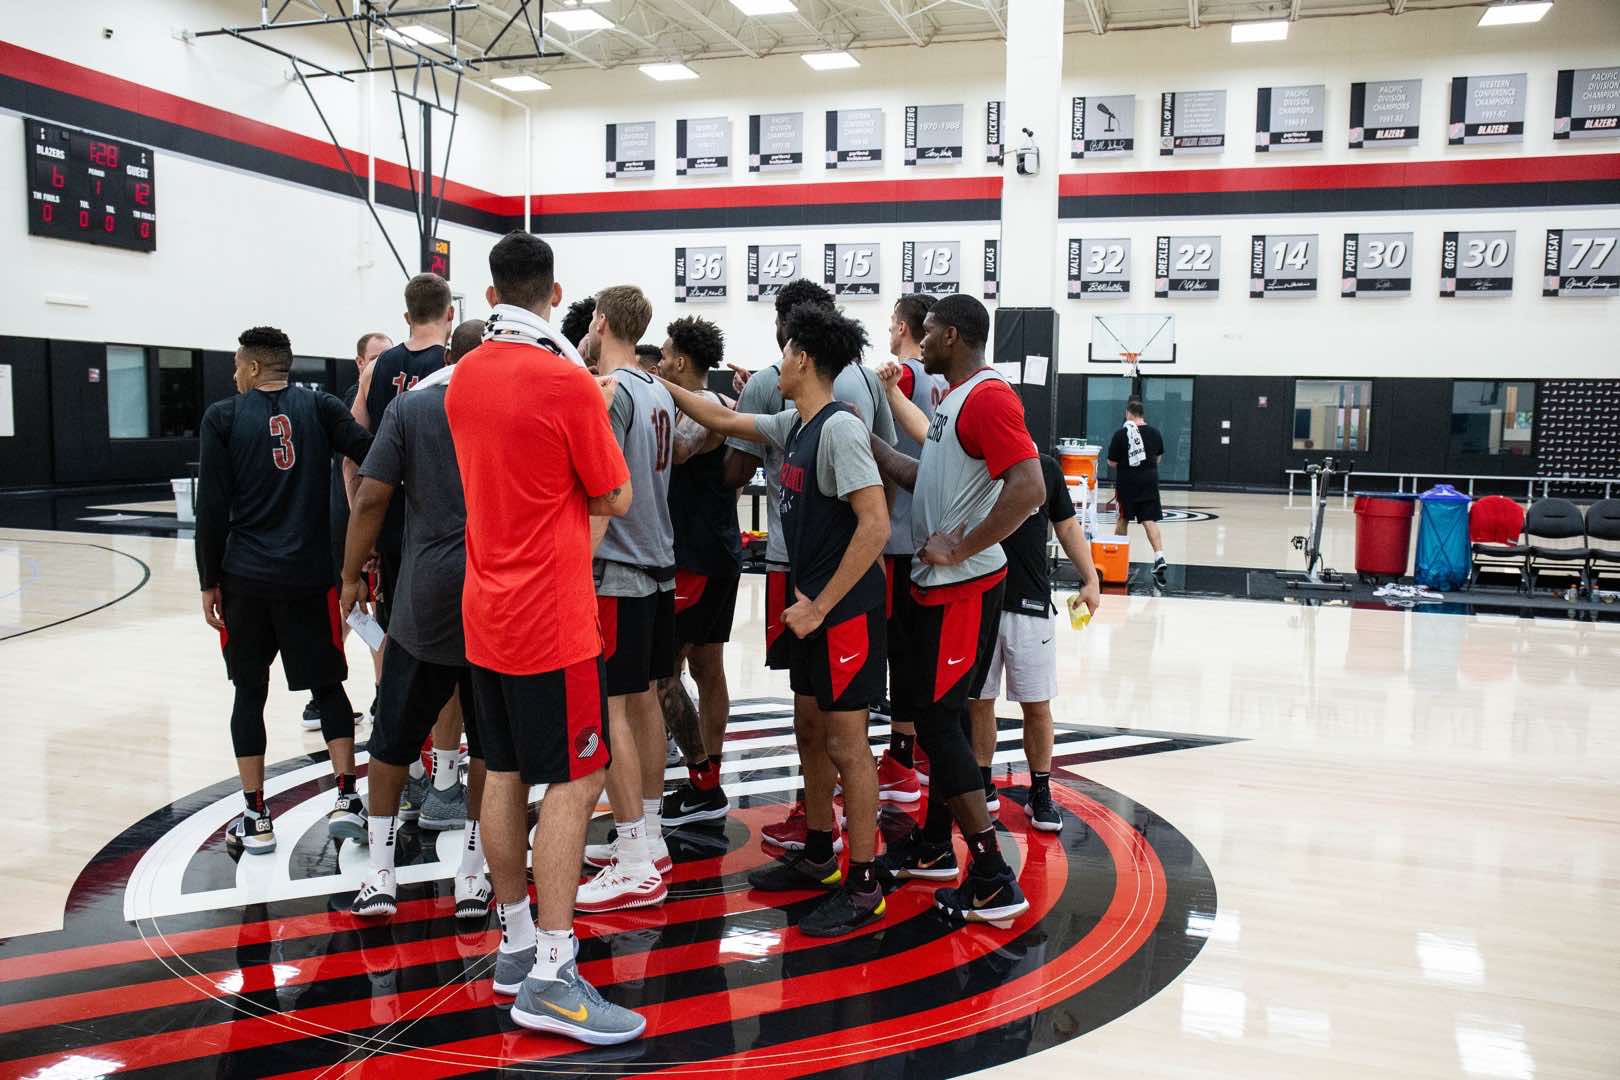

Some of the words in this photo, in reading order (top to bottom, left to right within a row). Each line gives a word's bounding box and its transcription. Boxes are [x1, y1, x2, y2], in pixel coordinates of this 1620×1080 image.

[905, 107, 915, 146] WEINBERG
[988, 102, 998, 143] GLICKMAN
[1074, 97, 1084, 139] SCHONELY
[1477, 124, 1509, 135] BLAZERS
[1584, 118, 1618, 129] BLAZERS
[1375, 129, 1406, 139] BLAZERS
[36, 144, 65, 160] BLAZERS
[676, 257, 685, 276] NEAL
[749, 252, 757, 277] PETRIE
[762, 250, 797, 278] 45
[825, 249, 834, 276] STEELE
[842, 249, 873, 277] 15
[904, 243, 913, 281] TWARDZIK
[921, 247, 953, 276] 13
[985, 248, 994, 272] LUCAS
[1069, 242, 1080, 276] WALTON
[1087, 244, 1125, 275] 32
[1157, 238, 1169, 276] DREXLER
[1175, 243, 1213, 272] 22
[1253, 240, 1264, 274] HOLLINS
[1272, 241, 1309, 271] 14
[1345, 239, 1357, 272] PORTER
[1363, 240, 1407, 270] 30
[1444, 240, 1456, 270] GROSS
[1463, 238, 1509, 269] 30
[1547, 233, 1560, 270] RAMSAY
[1568, 237, 1617, 270] 77
[690, 254, 723, 280] 36
[269, 413, 296, 470] 3
[651, 407, 671, 472] 10
